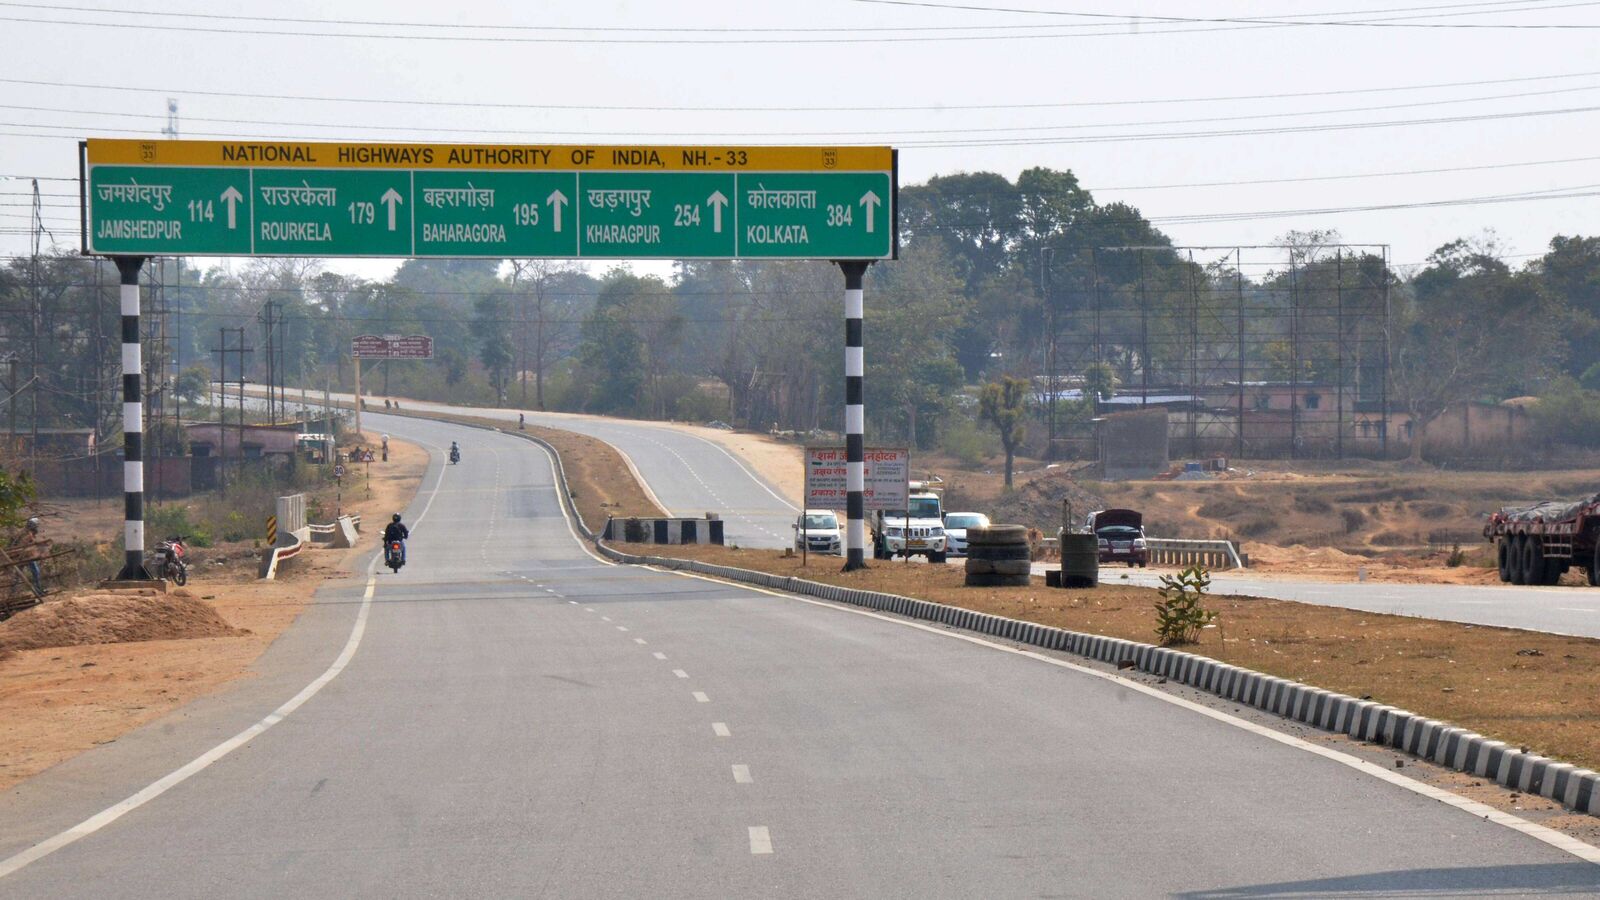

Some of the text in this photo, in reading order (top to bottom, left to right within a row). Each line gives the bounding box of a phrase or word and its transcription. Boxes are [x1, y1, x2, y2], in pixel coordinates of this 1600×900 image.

[223, 145, 316, 162] NATIONAL
[339, 148, 433, 163] HIGHWAYS
[448, 149, 550, 164] AUTHORITY
[572, 150, 595, 164] OF
[613, 150, 664, 167] INDIA,
[98, 178, 172, 211] जमशेदपुर
[261, 181, 336, 206] राउरकेला
[424, 183, 494, 211] बहरागोड़ा
[588, 190, 651, 216] खड़गपुर
[748, 184, 817, 209] कोलकाता
[189, 200, 214, 222] 114
[349, 203, 375, 224] 179
[514, 204, 539, 225] 195
[675, 205, 701, 226] 254
[827, 205, 853, 226] 384
[98, 220, 182, 239] JAMSHEDPUR
[262, 222, 332, 241] ROURKELA
[424, 224, 506, 242] BAHARAGORA
[588, 225, 660, 244] KHARAGPUR
[748, 225, 809, 243] KOLKATA
